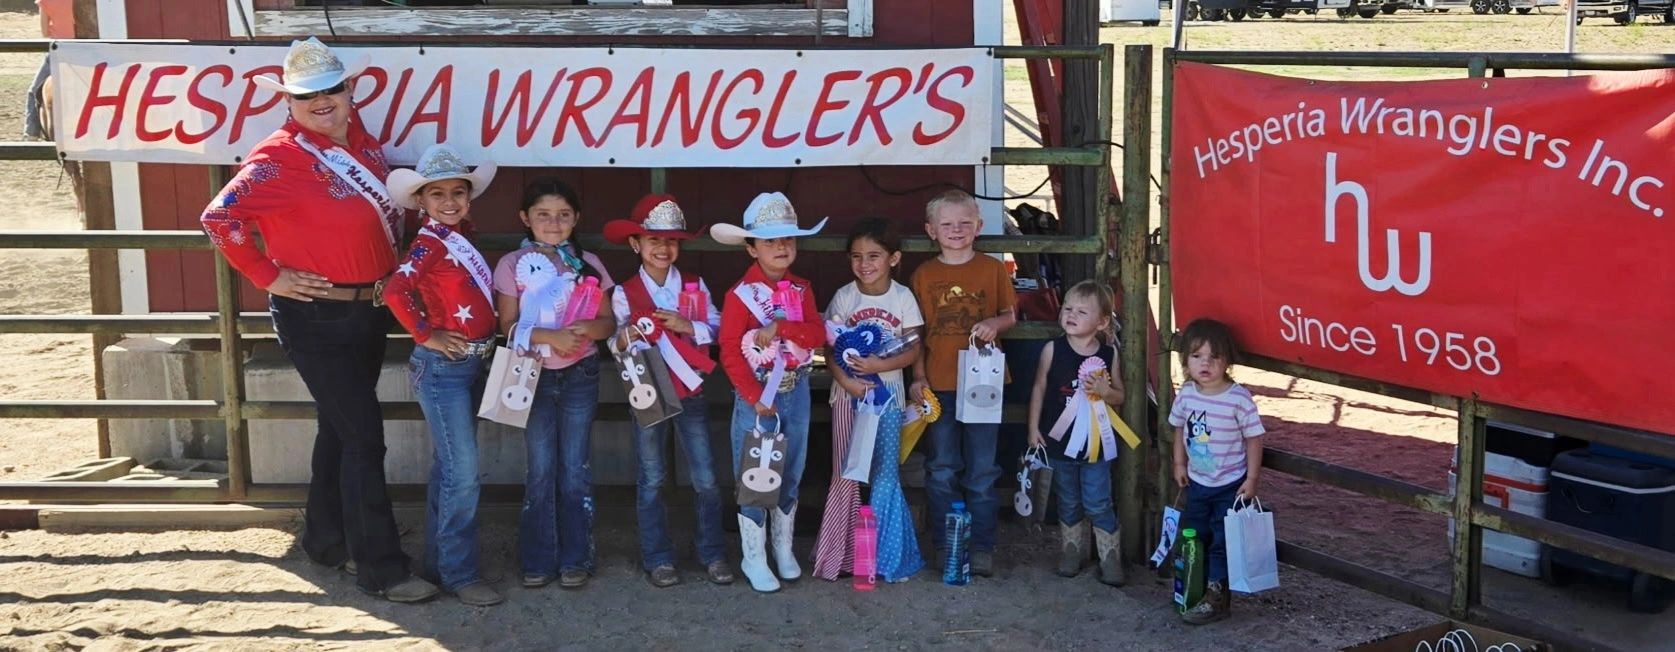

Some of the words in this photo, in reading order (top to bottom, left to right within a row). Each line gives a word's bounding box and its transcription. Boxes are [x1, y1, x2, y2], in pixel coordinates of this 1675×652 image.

[75, 63, 453, 145] HESPIA
[481, 62, 974, 149] WRANGLER'S
[1193, 101, 1326, 179] Hesperia
[1339, 96, 1571, 169] Wranglers
[1578, 138, 1665, 218] Inc.
[1279, 304, 1377, 357] Since
[1391, 323, 1501, 376] 1958
